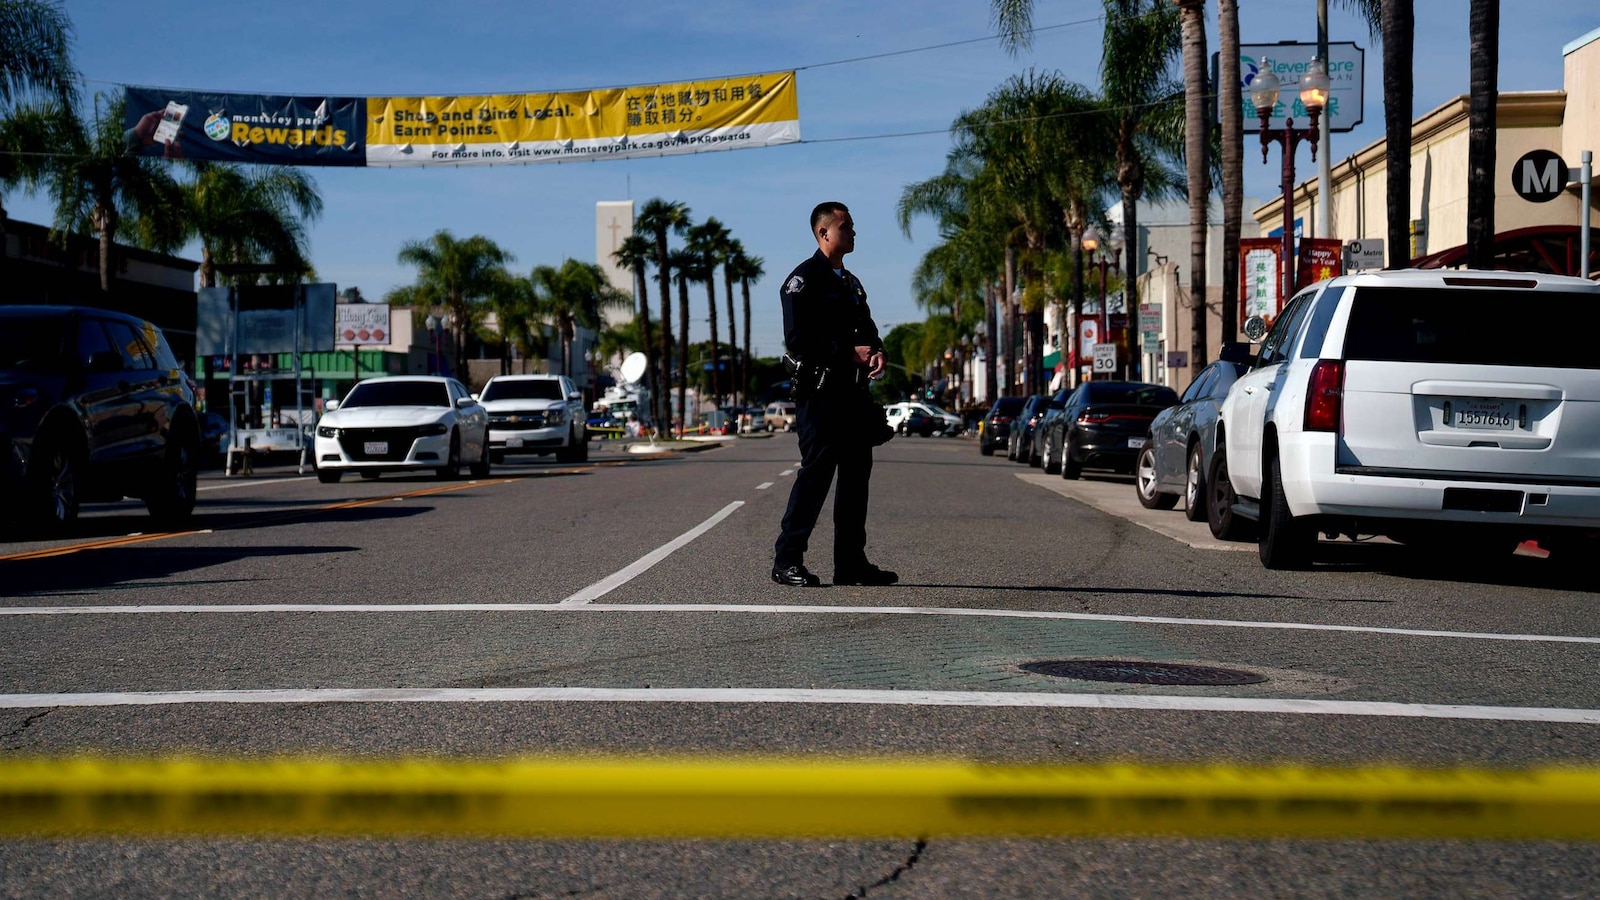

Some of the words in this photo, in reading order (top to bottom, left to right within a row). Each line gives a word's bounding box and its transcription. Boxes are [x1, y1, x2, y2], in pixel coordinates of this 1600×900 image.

[1328, 61, 1353, 72] are
[232, 115, 292, 126] monterey
[297, 115, 325, 126] park
[394, 110, 438, 123] Shop
[442, 109, 472, 121] and
[479, 107, 518, 121] Dine
[524, 105, 574, 120] Local.
[231, 122, 347, 146] Rewards
[394, 124, 432, 137] Earn
[438, 123, 498, 136] Points.
[432, 151, 449, 159] For
[452, 150, 478, 159] more
[508, 148, 530, 157] visit
[533, 132, 751, 156] www.montereypark.ca.gov/MPKRewards
[1522, 158, 1559, 194] M
[1308, 249, 1332, 258] Happy
[1302, 257, 1318, 265] New
[1320, 257, 1336, 266] Year
[1096, 358, 1114, 369] 30
[1459, 410, 1511, 425] 1557616
